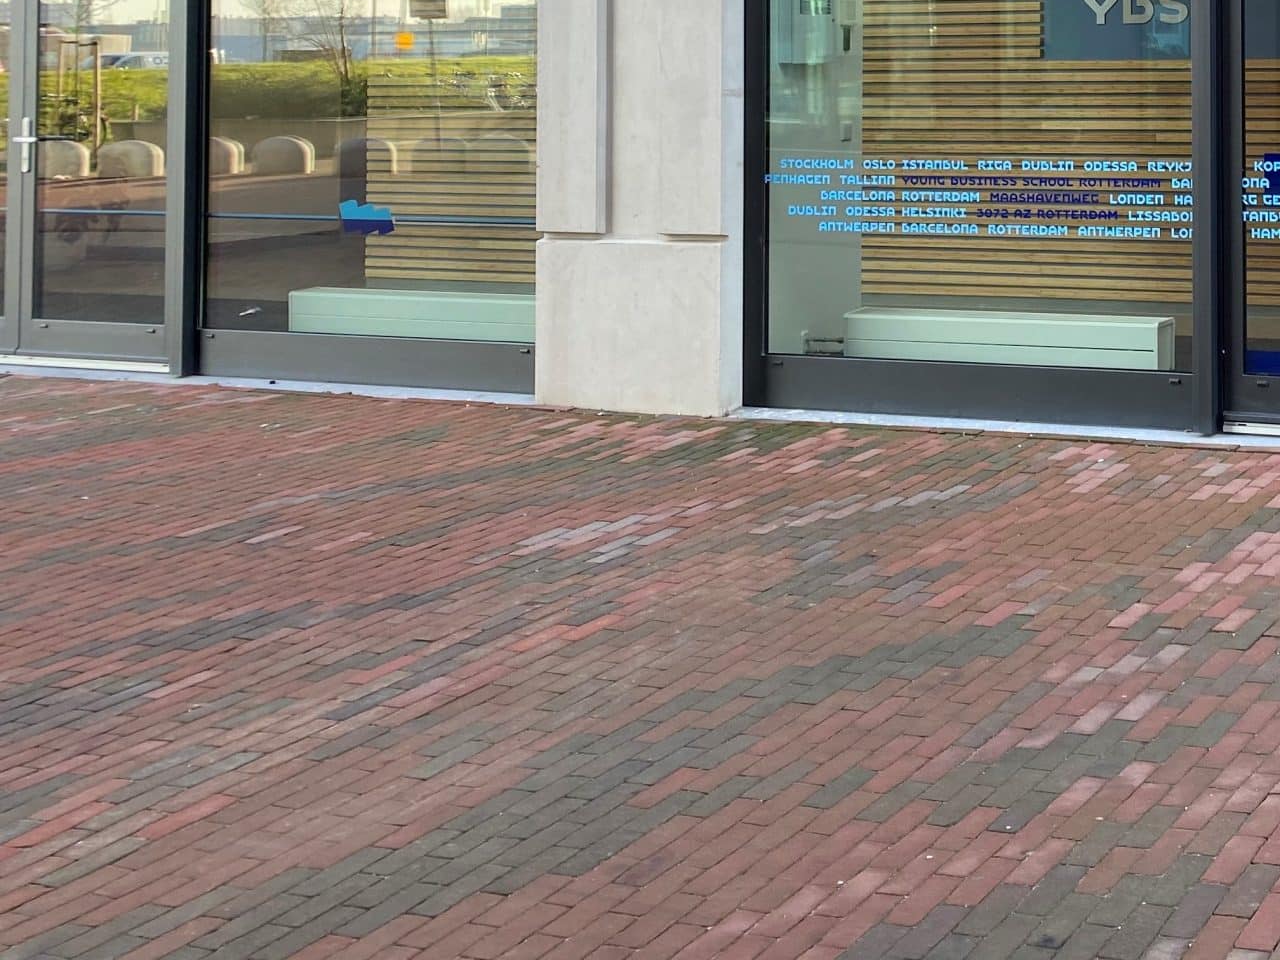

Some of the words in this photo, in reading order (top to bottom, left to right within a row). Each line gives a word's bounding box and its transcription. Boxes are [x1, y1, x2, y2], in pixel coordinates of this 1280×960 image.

[780, 159, 854, 170] STOCKHOLM
[863, 160, 896, 170] OSLO
[902, 160, 968, 171] ISTANBUL
[977, 160, 1012, 171] RIGA
[1022, 160, 1074, 172] DUBLIN
[1084, 161, 1138, 172] ODESSA
[840, 175, 896, 185] TALLINN
[902, 176, 946, 186] YOUNG
[951, 176, 1017, 187] BUSINESS
[1023, 177, 1073, 187] SCHOOL
[1079, 177, 1161, 188] ROTTERDAM
[820, 191, 896, 202] BARCELONA
[901, 191, 980, 203] ROTTERDAM
[990, 192, 1099, 204] MAASHAVENWEG
[1110, 194, 1164, 205] LONDEN
[788, 205, 837, 216] DUBLIN
[846, 206, 896, 217] ODESSA
[901, 207, 967, 218] HELSINKI
[976, 208, 1009, 218] 3072
[1013, 209, 1032, 219] AZ
[1037, 209, 1119, 220] ROTTERDAM
[818, 222, 895, 233] ANTWERPEN
[901, 223, 979, 234] BARCELONA
[987, 224, 1068, 236] ROTTERDAM
[1078, 226, 1161, 238] ANTWERPEN
